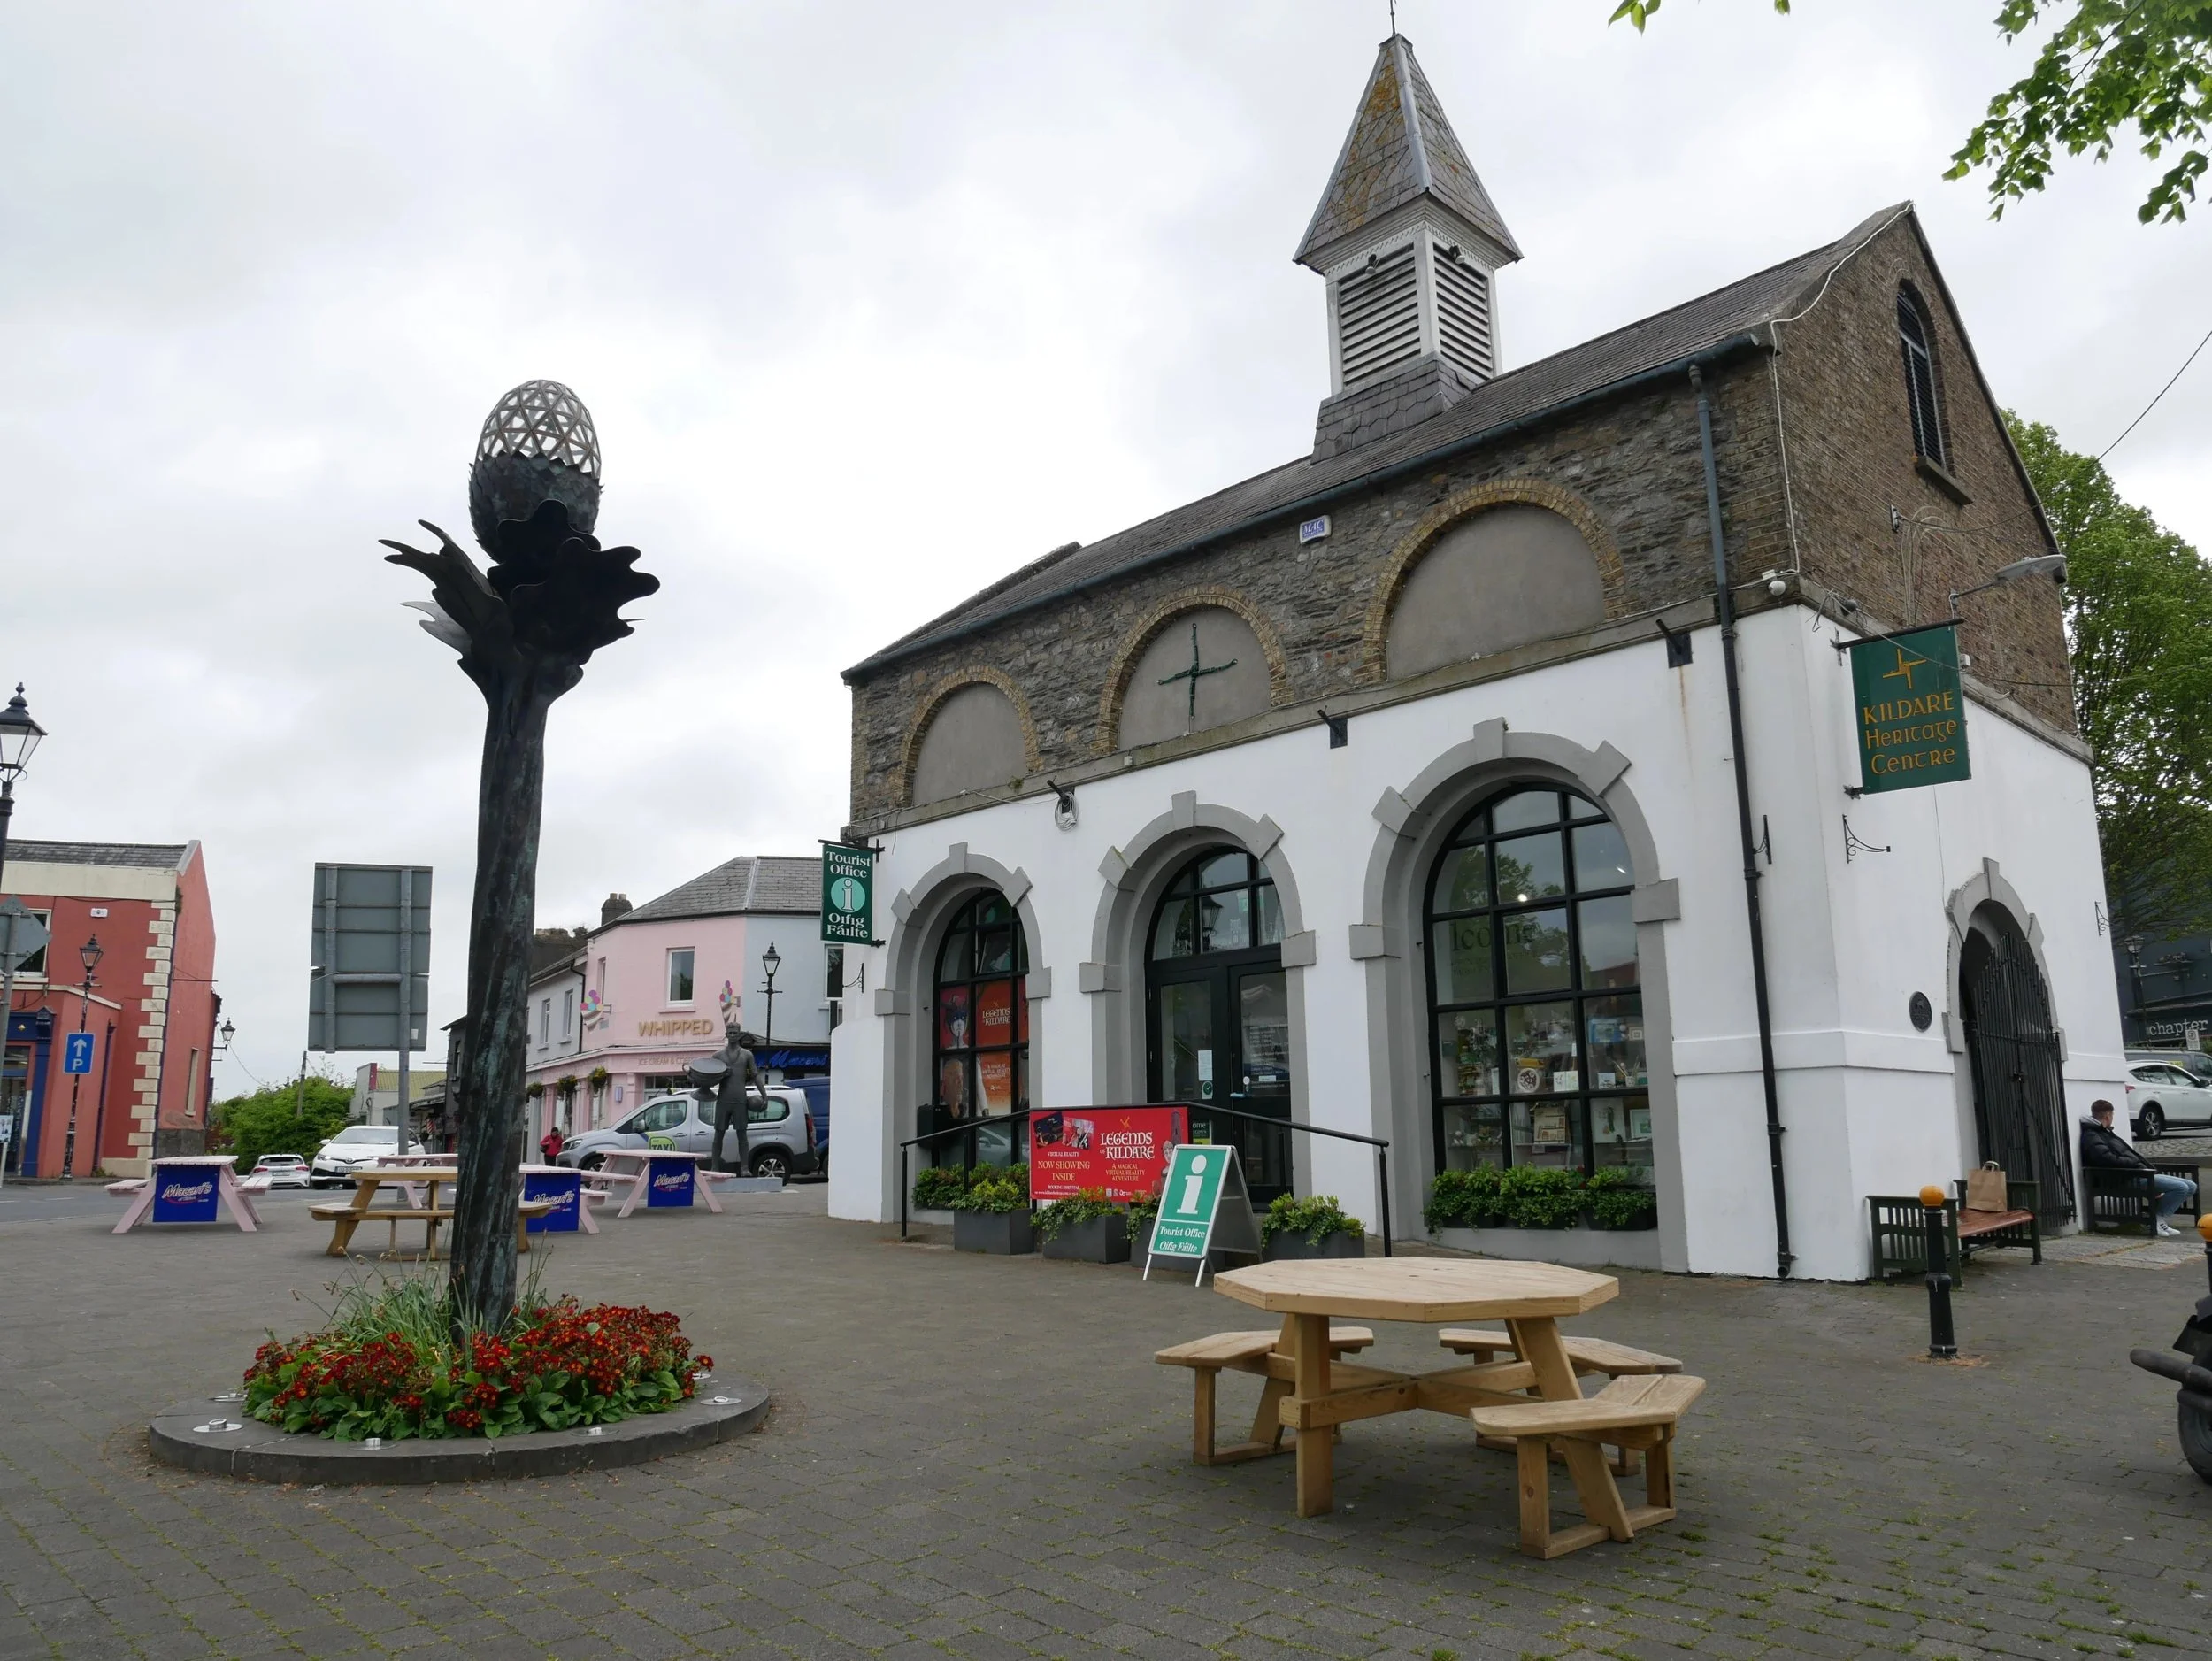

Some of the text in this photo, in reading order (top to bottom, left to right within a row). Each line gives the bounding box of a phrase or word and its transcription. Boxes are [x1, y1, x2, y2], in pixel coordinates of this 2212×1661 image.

[1863, 690, 1955, 725] KILDARE
[826, 851, 871, 867] Tourist
[829, 864, 867, 879] Office
[638, 1019, 714, 1037] WHIPPED
[2149, 1019, 2208, 1036] chapter
[72, 1058, 83, 1071] P
[1100, 1132, 1153, 1146] LEGENDS
[1105, 1145, 1155, 1160] KILDARE
[1037, 1160, 1090, 1170] NOW SHOWING
[1052, 1173, 1075, 1181] INSIDE
[161, 1181, 213, 1199] Macari's
[1159, 1226, 1205, 1239] Tourist Office
